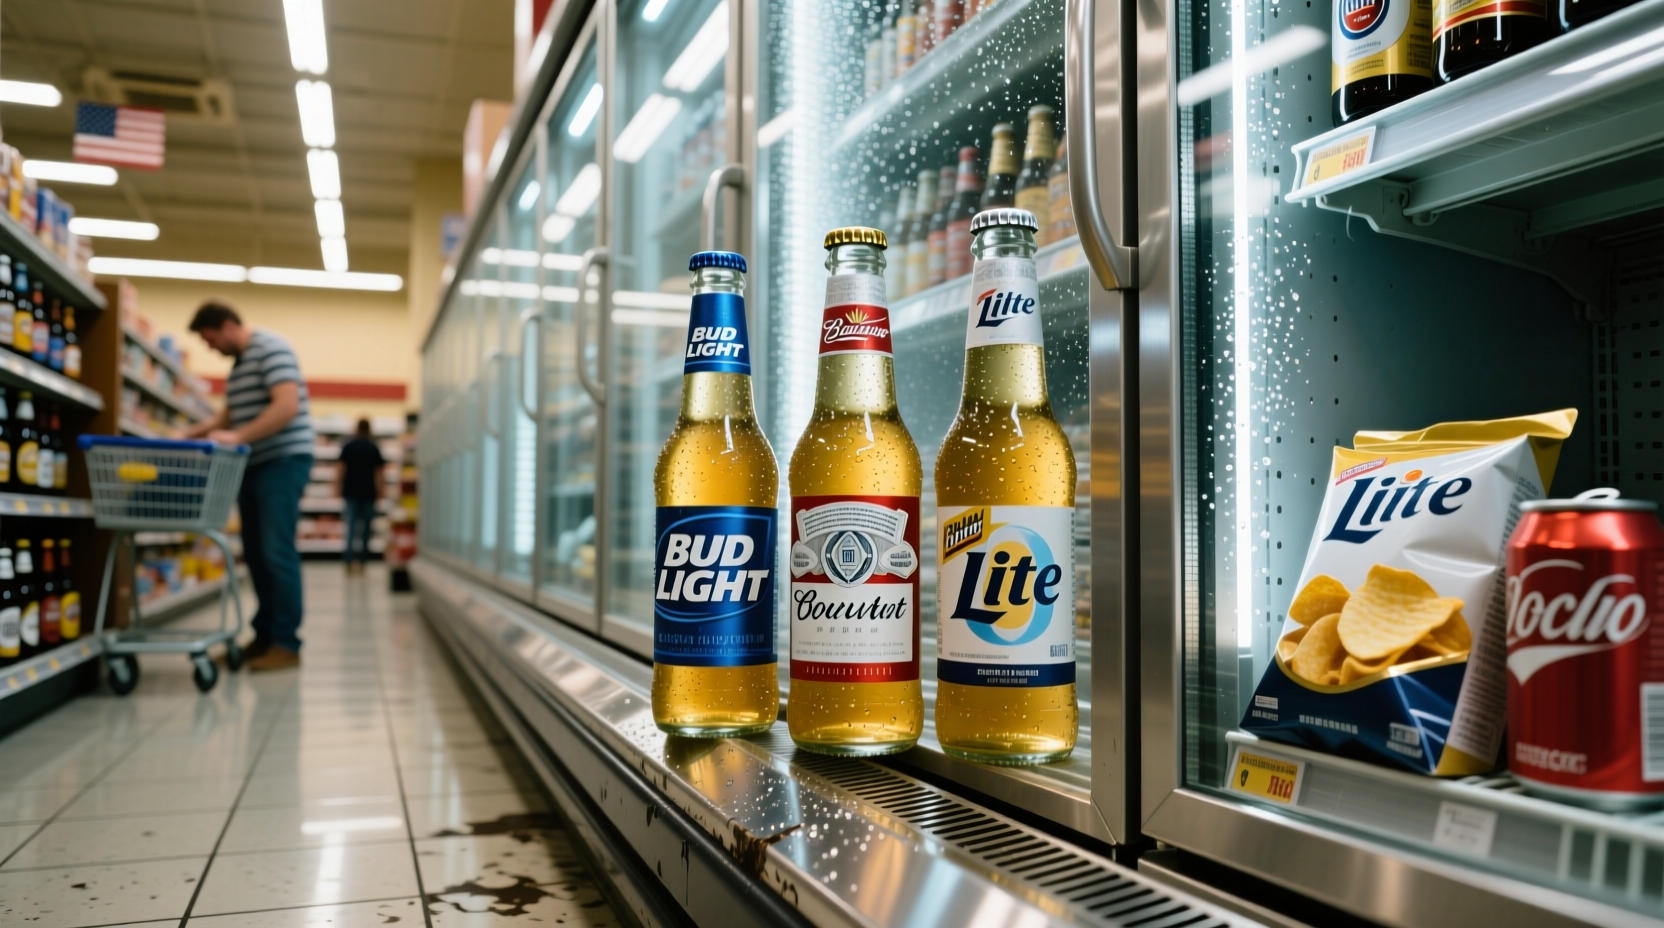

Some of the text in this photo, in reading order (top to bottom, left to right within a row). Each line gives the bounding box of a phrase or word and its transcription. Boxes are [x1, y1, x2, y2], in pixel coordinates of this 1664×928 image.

[686, 342, 744, 358] LIGHT
[691, 326, 737, 343] BUD
[663, 533, 755, 568] BUD
[655, 569, 770, 602] LIGHT
[950, 550, 1062, 625] Lite
